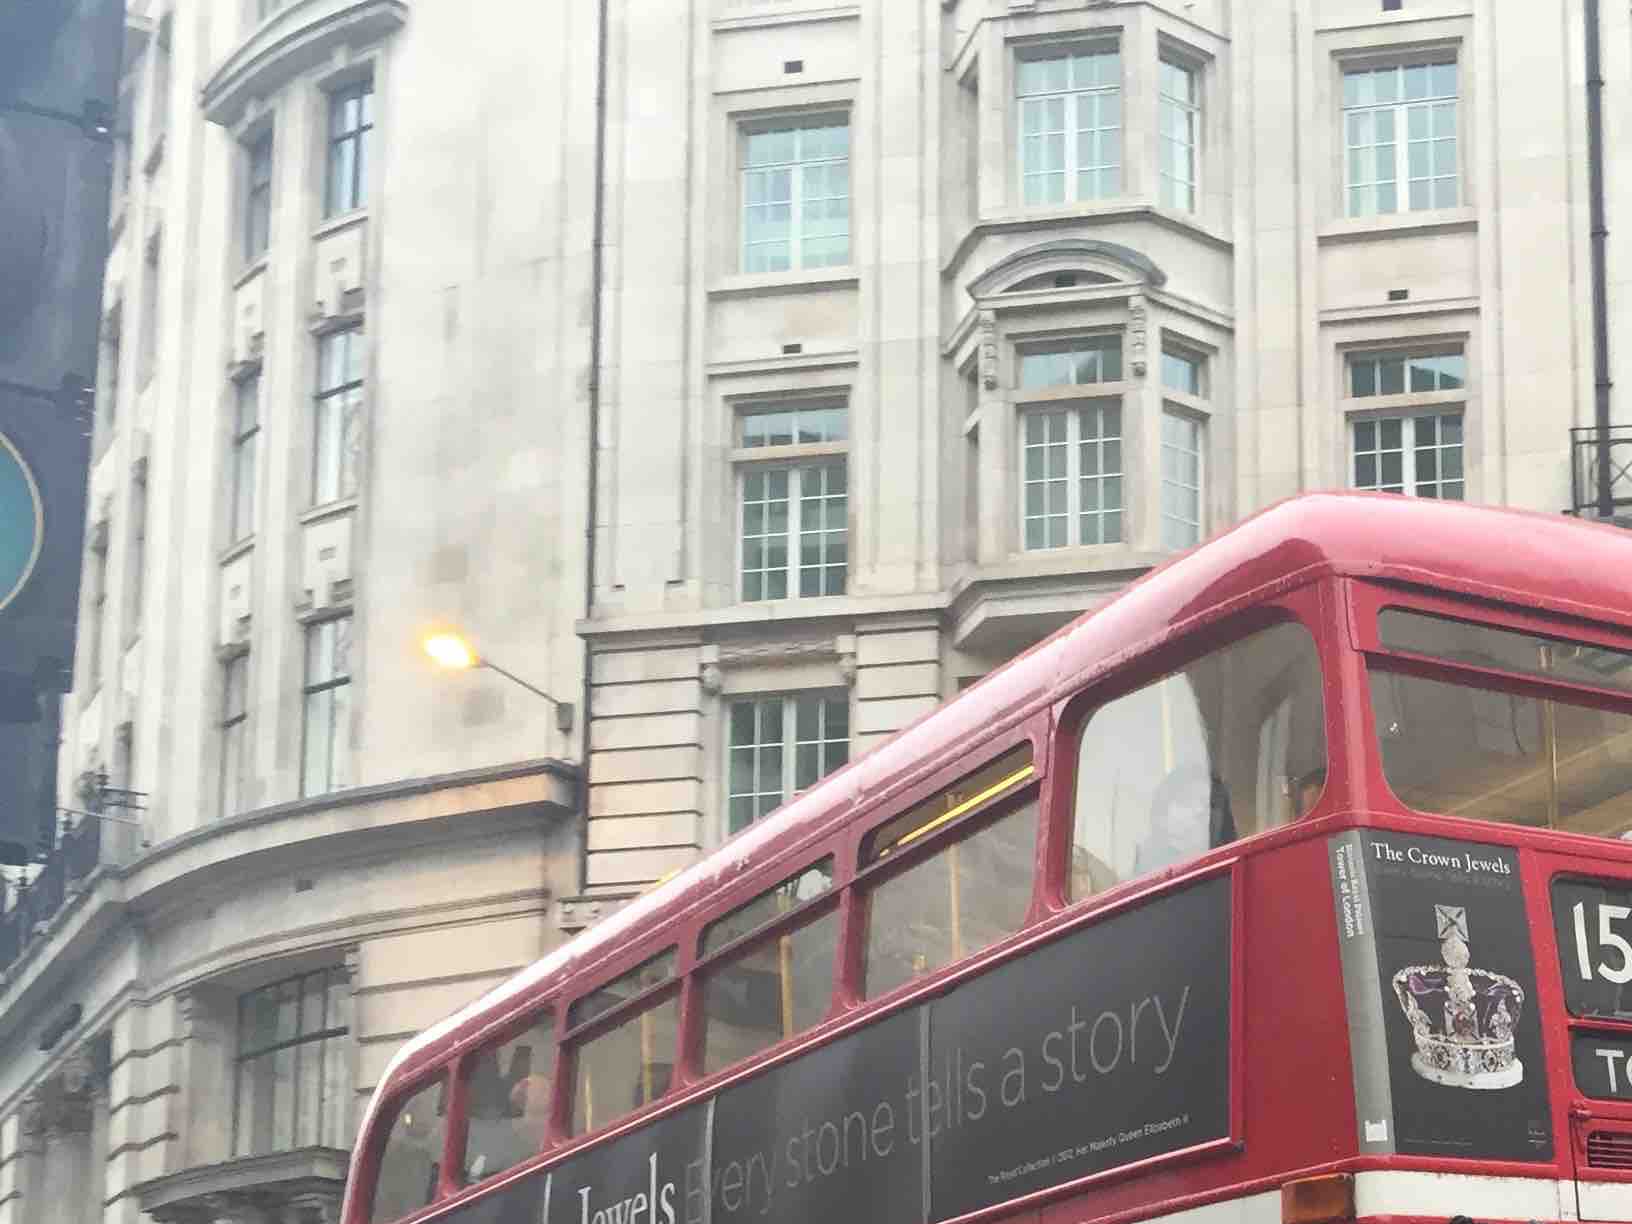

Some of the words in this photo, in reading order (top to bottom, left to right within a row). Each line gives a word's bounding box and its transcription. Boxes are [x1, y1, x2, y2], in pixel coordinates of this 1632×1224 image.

[1369, 841, 1403, 862] The
[1407, 848, 1461, 869] Crown
[1465, 853, 1512, 875] Jewels
[784, 1101, 896, 1188] stone
[905, 1046, 987, 1145] tells
[1000, 1047, 1025, 1107] a
[1040, 984, 1191, 1092] story
